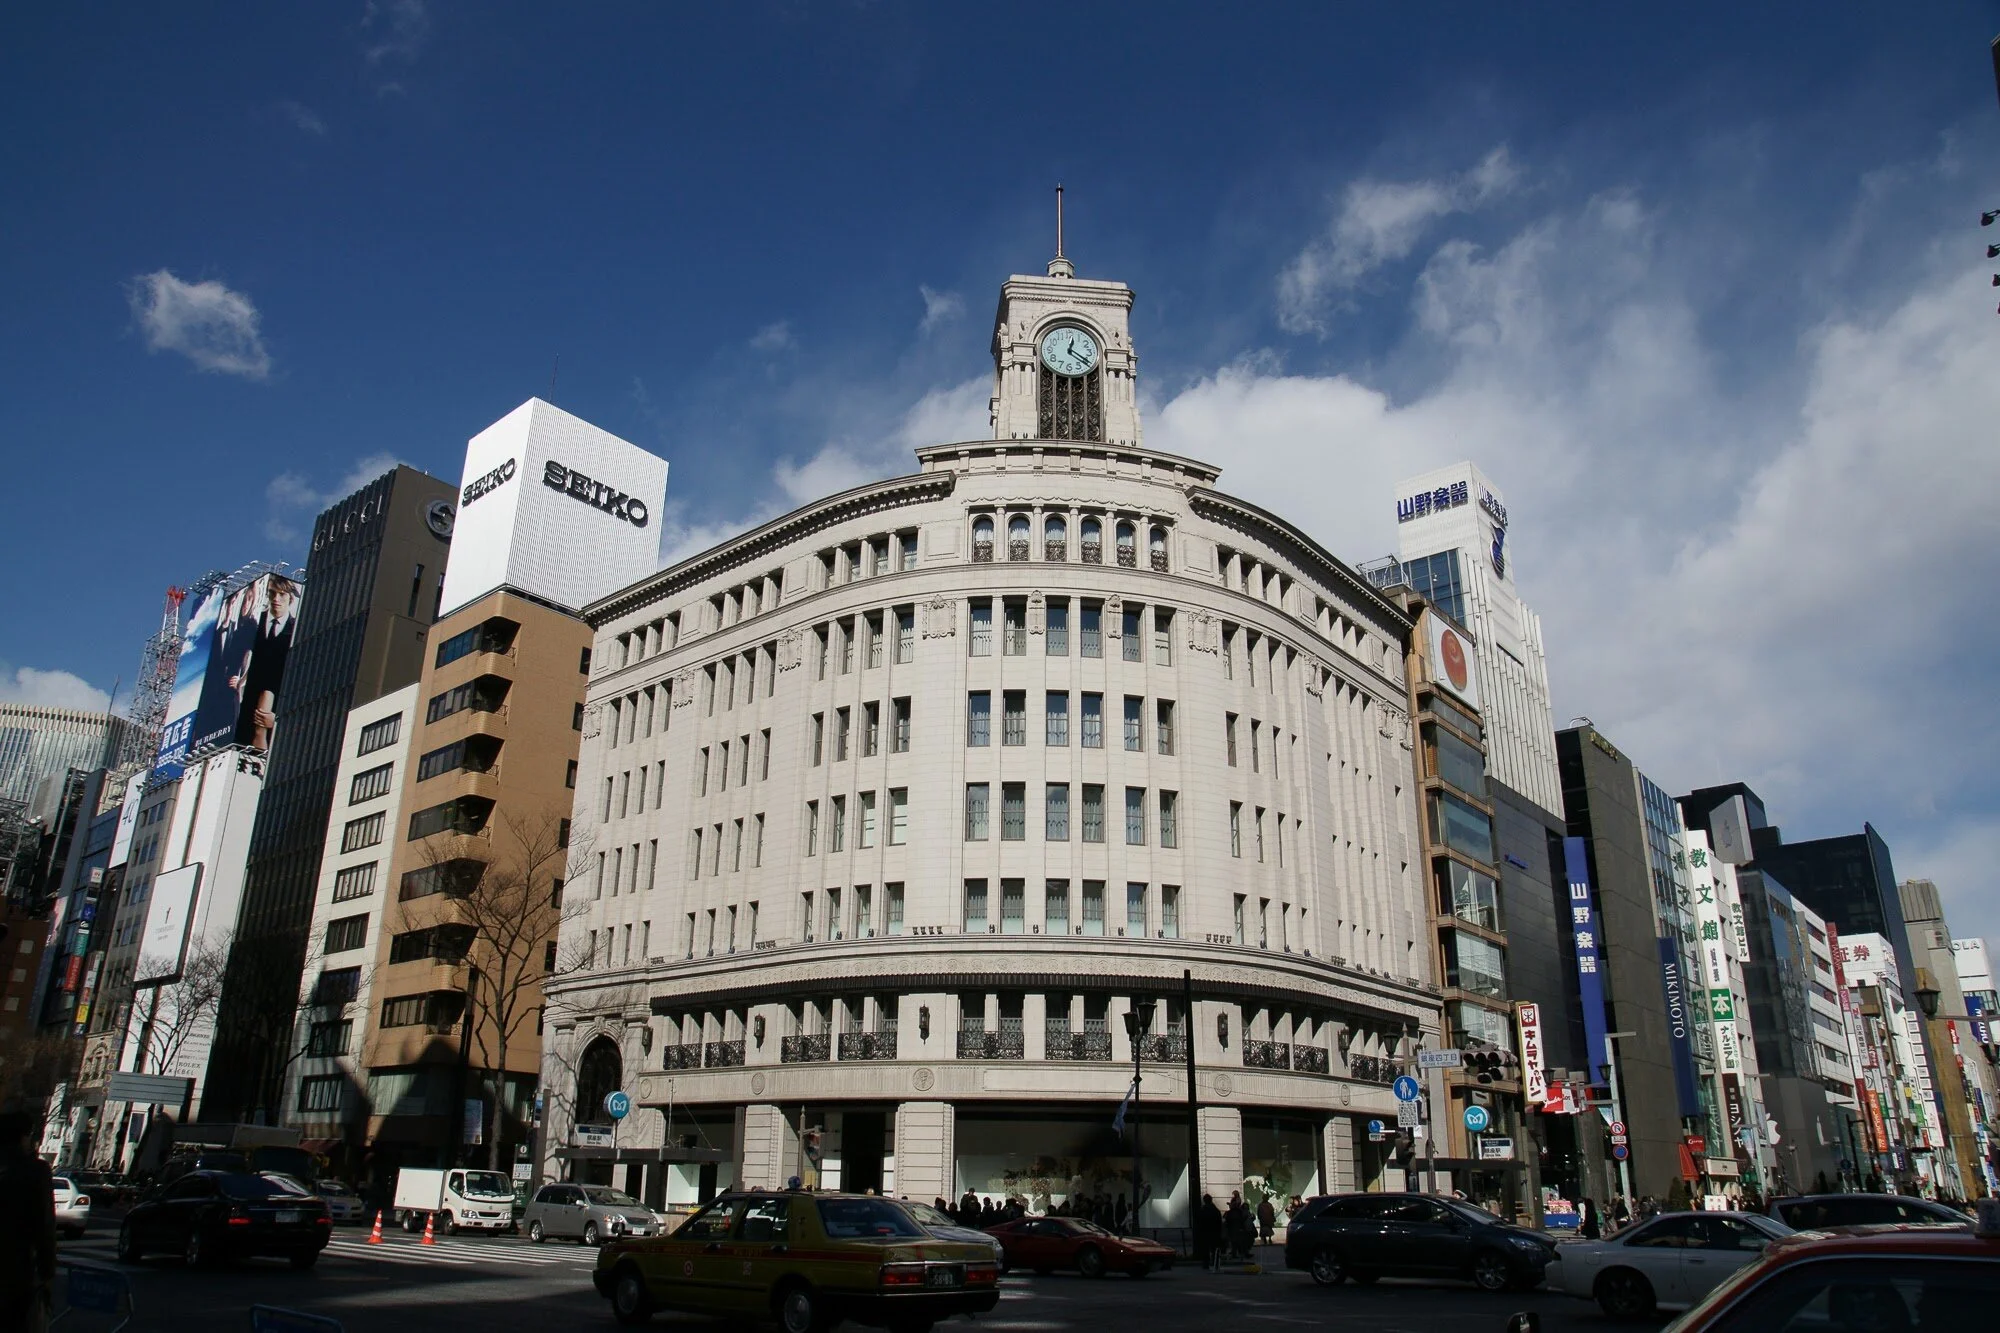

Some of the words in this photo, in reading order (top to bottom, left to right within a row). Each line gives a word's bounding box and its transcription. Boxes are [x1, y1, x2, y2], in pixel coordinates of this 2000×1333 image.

[1046, 346, 1054, 354] 9
[1049, 354, 1057, 362] 8
[1082, 340, 1090, 348] 2
[1086, 348, 1093, 357] 3
[1057, 360, 1065, 369] 7
[1066, 363, 1073, 371] 6
[1075, 361, 1082, 370] 5
[462, 458, 517, 507] SEIKO
[543, 460, 649, 527] SEIKO
[1397, 481, 1468, 522] 山野楽器
[314, 494, 382, 552] GUCCI
[195, 725, 232, 748] BURBERRY
[1689, 848, 1719, 941] 教文館
[1570, 883, 1596, 973] 山野楽器
[1731, 902, 1748, 957] 教文館ビル
[1664, 963, 1685, 1039] MIKIMOTO
[1712, 993, 1731, 1015] 本
[1975, 1009, 1990, 1044] MZUHO
[1421, 1053, 1458, 1062] 銀座四丁目
[1524, 1029, 1541, 1097] キムラヤのパン
